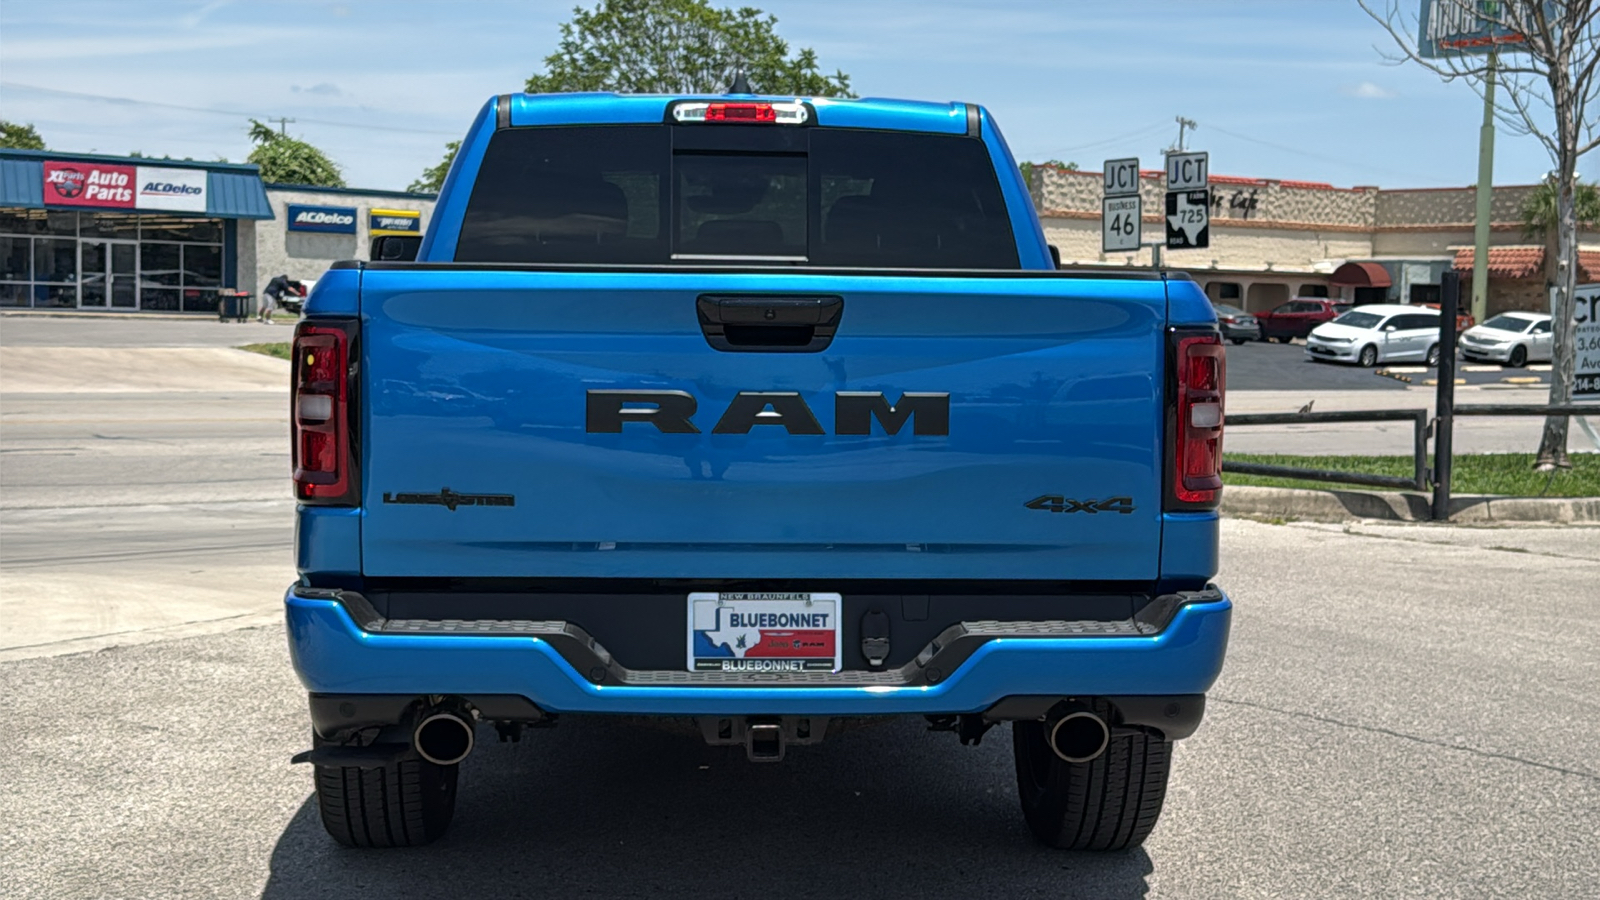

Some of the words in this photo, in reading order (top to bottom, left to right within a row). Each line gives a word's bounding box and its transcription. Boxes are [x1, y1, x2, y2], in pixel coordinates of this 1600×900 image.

[87, 169, 129, 186] Auto
[1106, 164, 1137, 189] JCT
[1170, 158, 1205, 184] JCT
[85, 185, 133, 202] Parts
[143, 182, 203, 195] ACDelco
[1189, 192, 1206, 201] FARM
[1108, 200, 1137, 212] BUSINESS
[295, 211, 354, 225] ACDelco
[1179, 209, 1204, 224] 725
[1110, 213, 1135, 237] 46
[586, 388, 950, 436] RAM
[1023, 494, 1137, 514] 4x4
[730, 613, 829, 628] BLUEBONNET
[722, 660, 805, 670] BLUEBONNET
